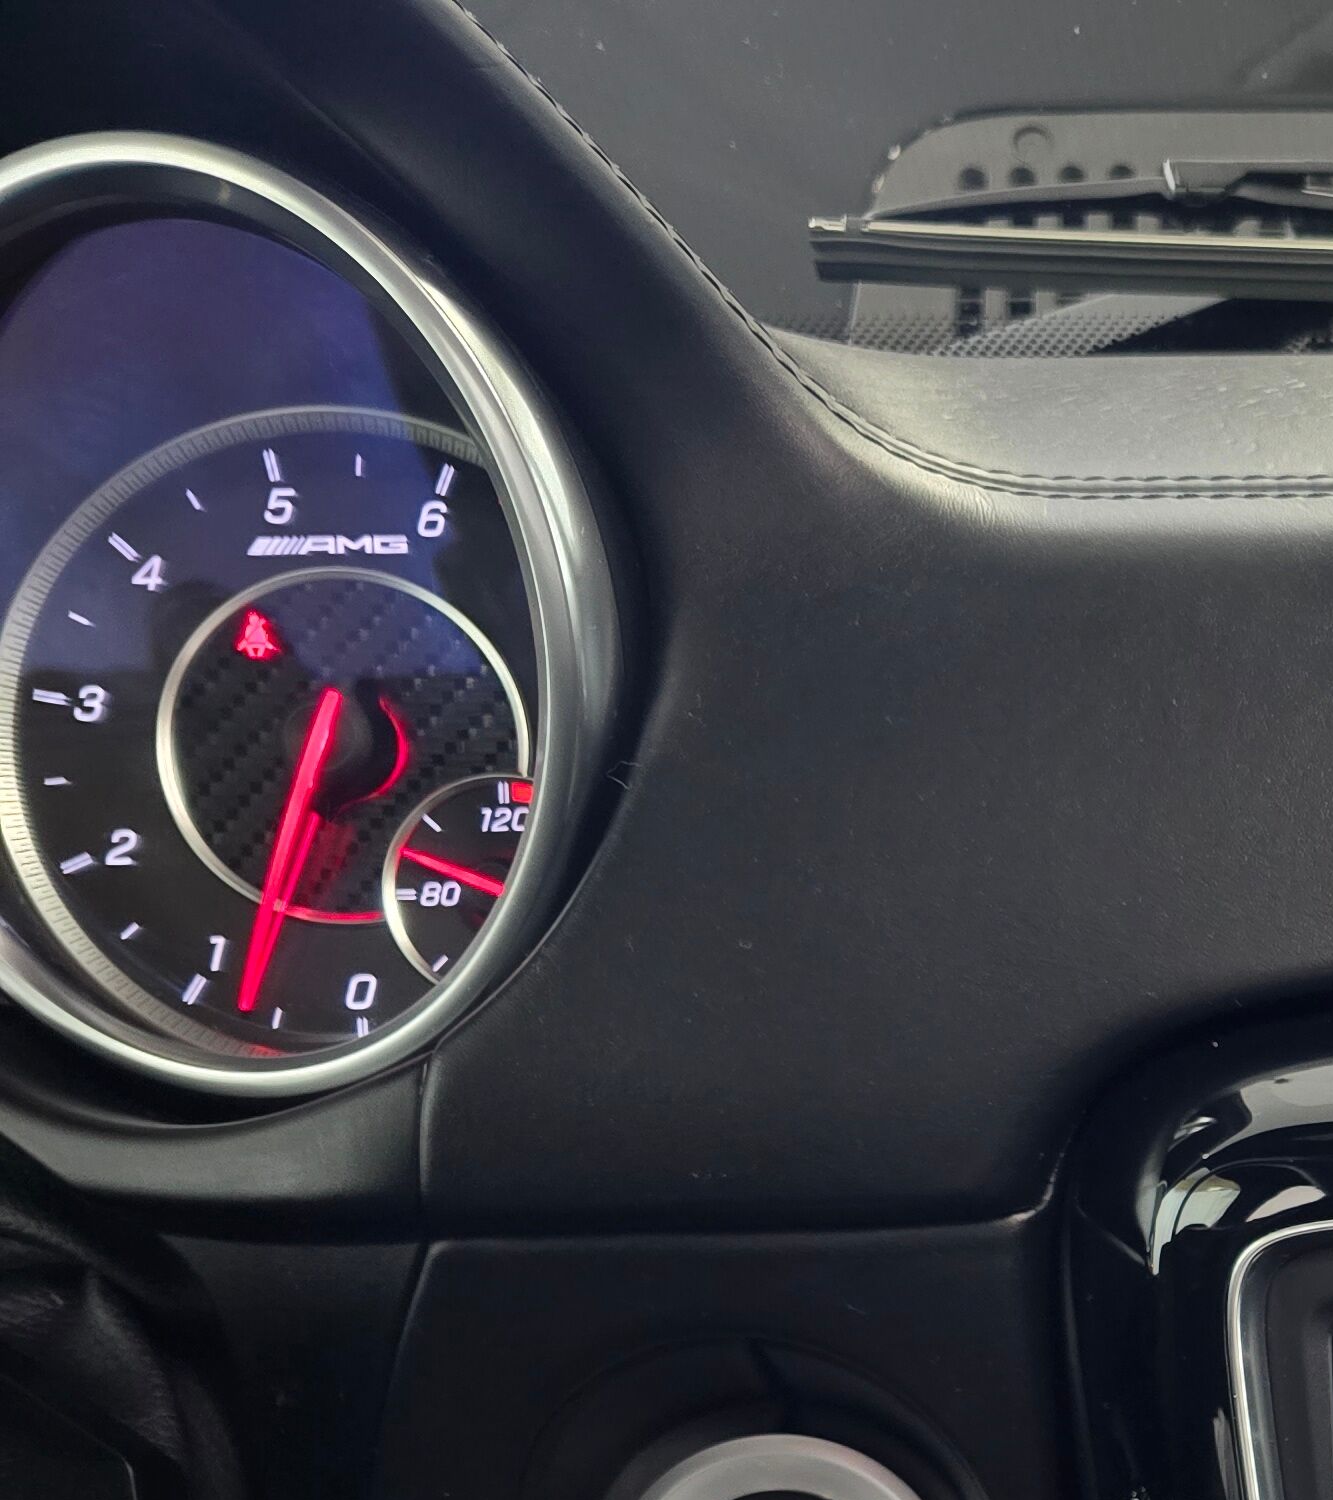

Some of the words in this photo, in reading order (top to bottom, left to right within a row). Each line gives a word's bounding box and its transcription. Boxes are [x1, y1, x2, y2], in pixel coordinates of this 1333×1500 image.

[264, 488, 297, 525] 5
[417, 501, 449, 538] 6
[132, 556, 166, 592] 4
[73, 686, 108, 721] 3
[104, 830, 139, 866] 2
[420, 881, 461, 907] 80
[209, 935, 227, 971] 1
[346, 973, 378, 1011] 0
